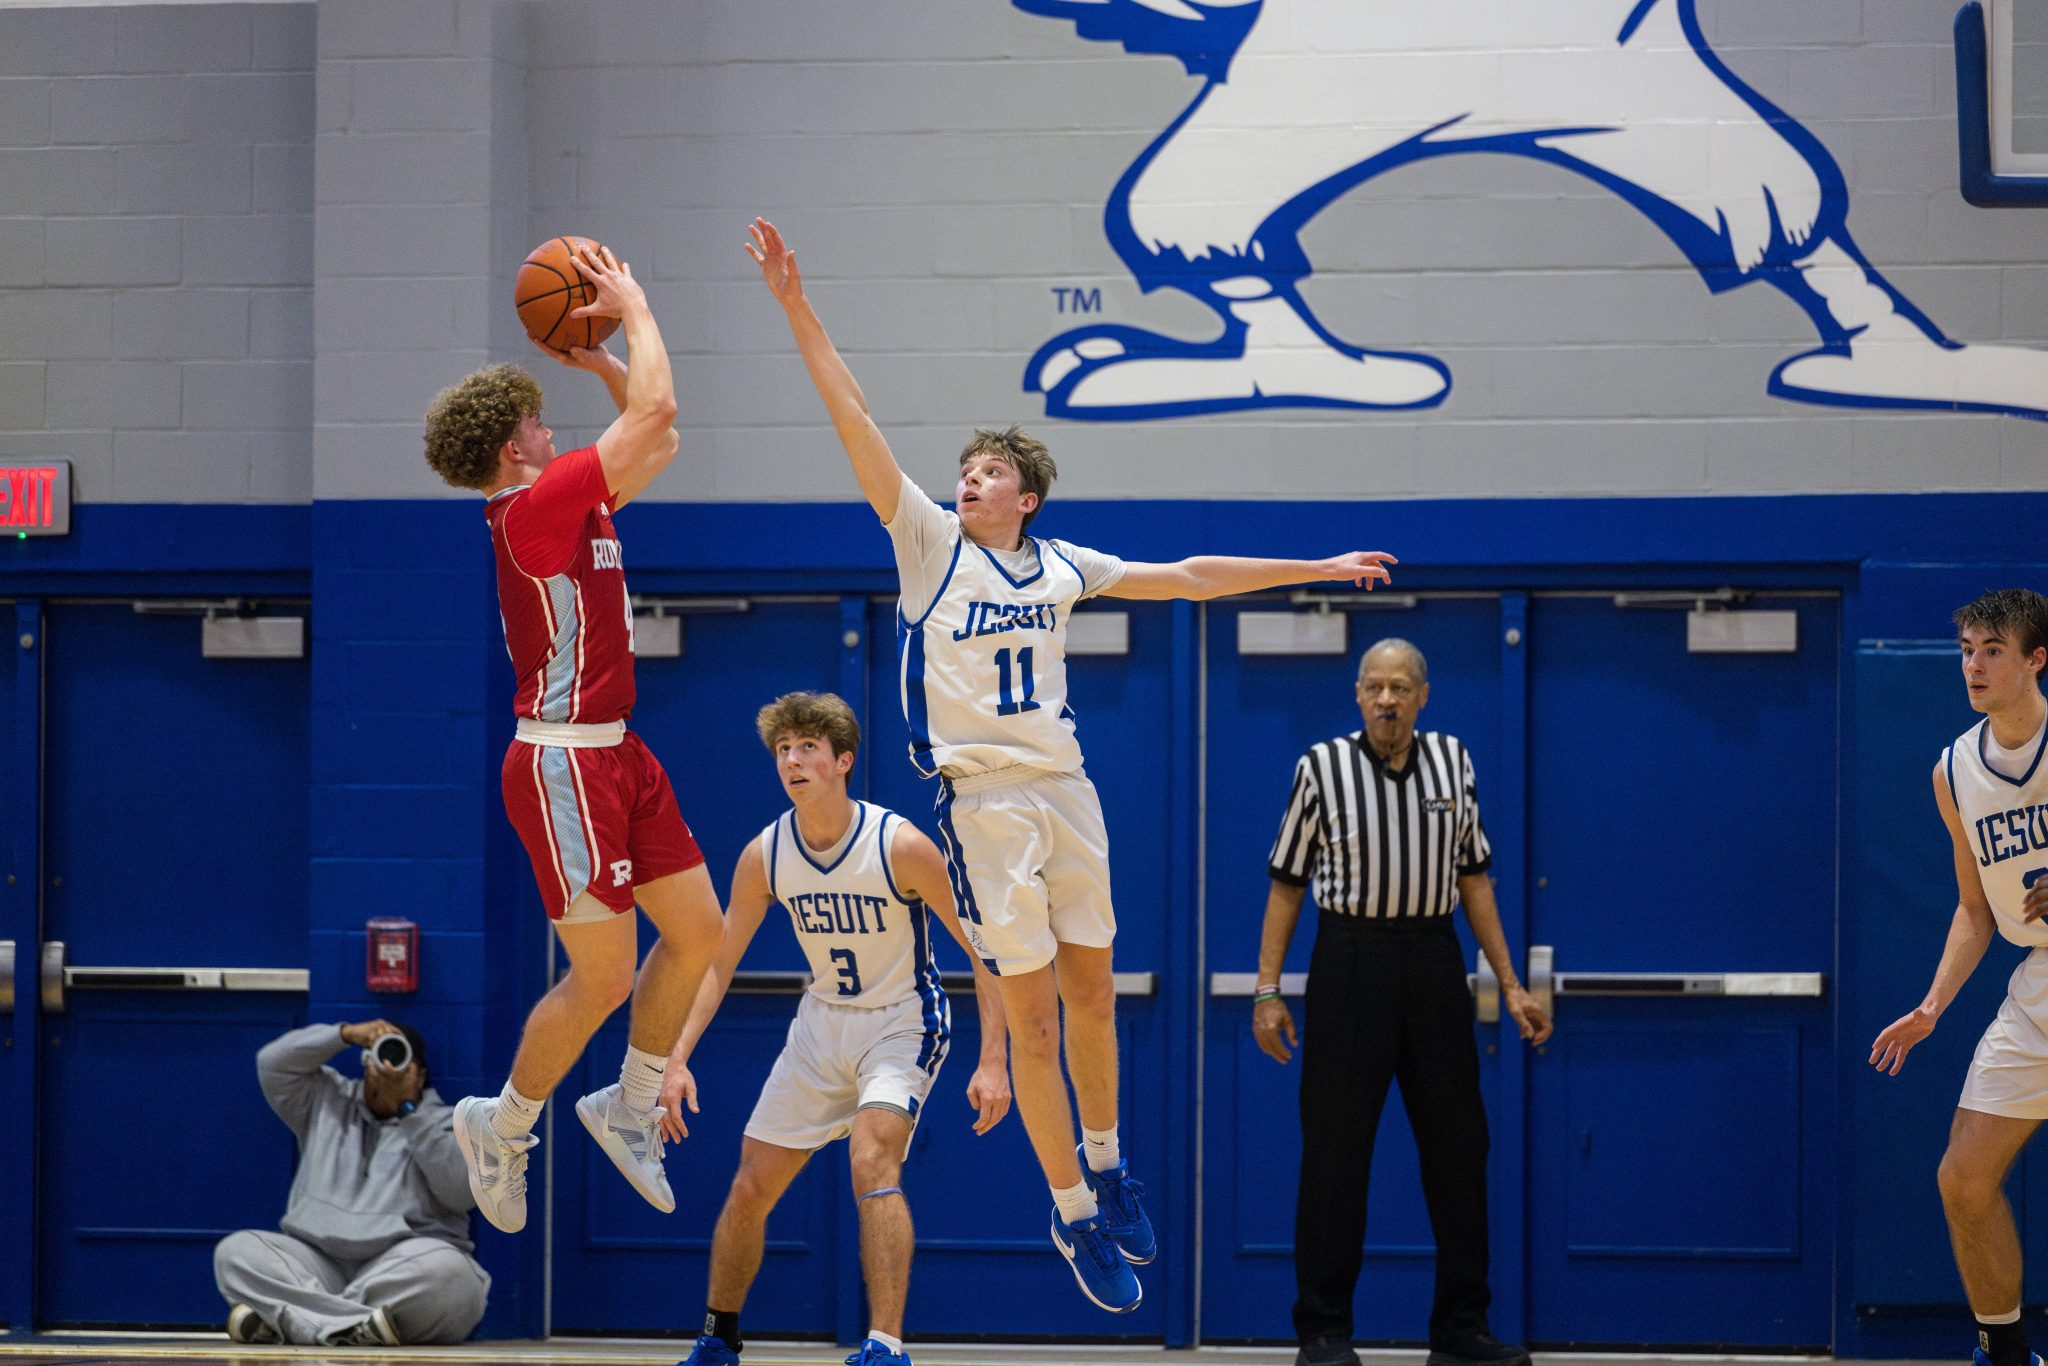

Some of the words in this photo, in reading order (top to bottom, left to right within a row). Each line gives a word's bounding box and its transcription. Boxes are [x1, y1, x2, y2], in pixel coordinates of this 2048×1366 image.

[1051, 287, 1102, 313] TM
[994, 646, 1041, 716] 11
[610, 859, 632, 887] R
[830, 947, 862, 995] 3
